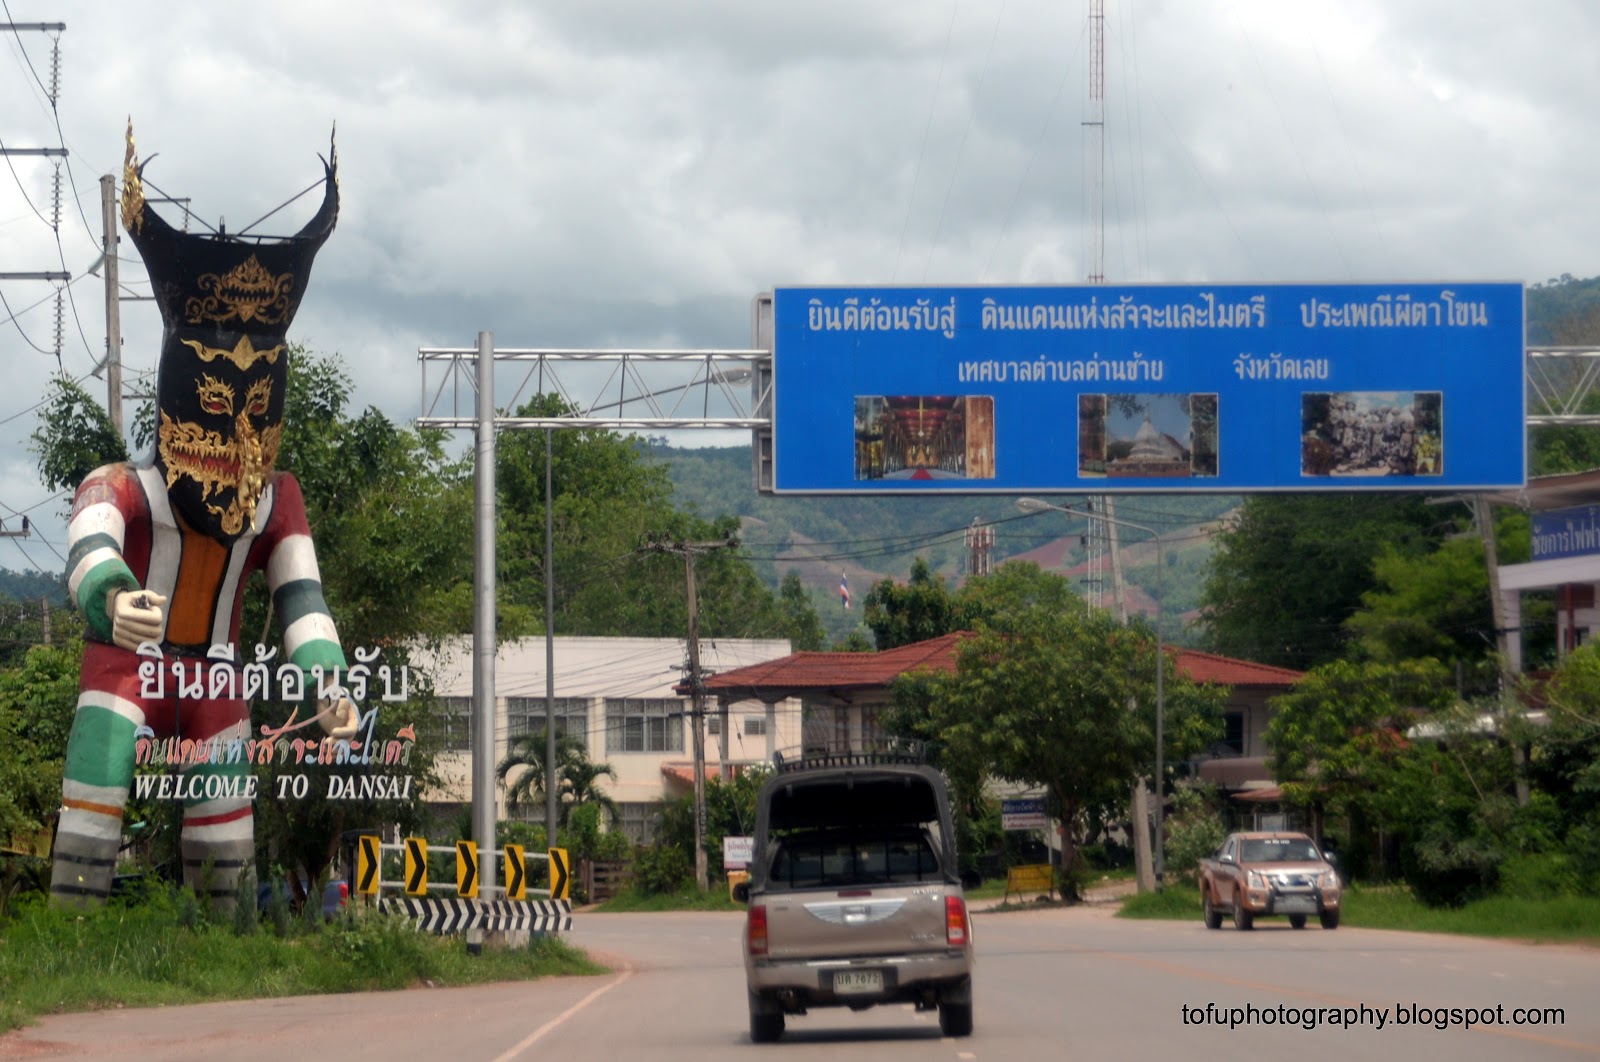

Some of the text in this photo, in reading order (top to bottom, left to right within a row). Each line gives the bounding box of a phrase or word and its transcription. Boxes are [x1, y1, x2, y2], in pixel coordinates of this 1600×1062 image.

[808, 290, 1488, 339] ยินดีต้อนรับสู่ ดินแดนแห่งสัจจะและไมตรี ประเพณีผีตาโขน
[958, 351, 1329, 382] เทศบาลตำบลด่านซ้าย จังหวัดเลย
[136, 641, 408, 702] ยินดีต้อนรับ
[134, 687, 416, 766] ดินแดนแห่งสัจจะและไมตรี
[134, 774, 413, 800] WELCOME TO DANSAI
